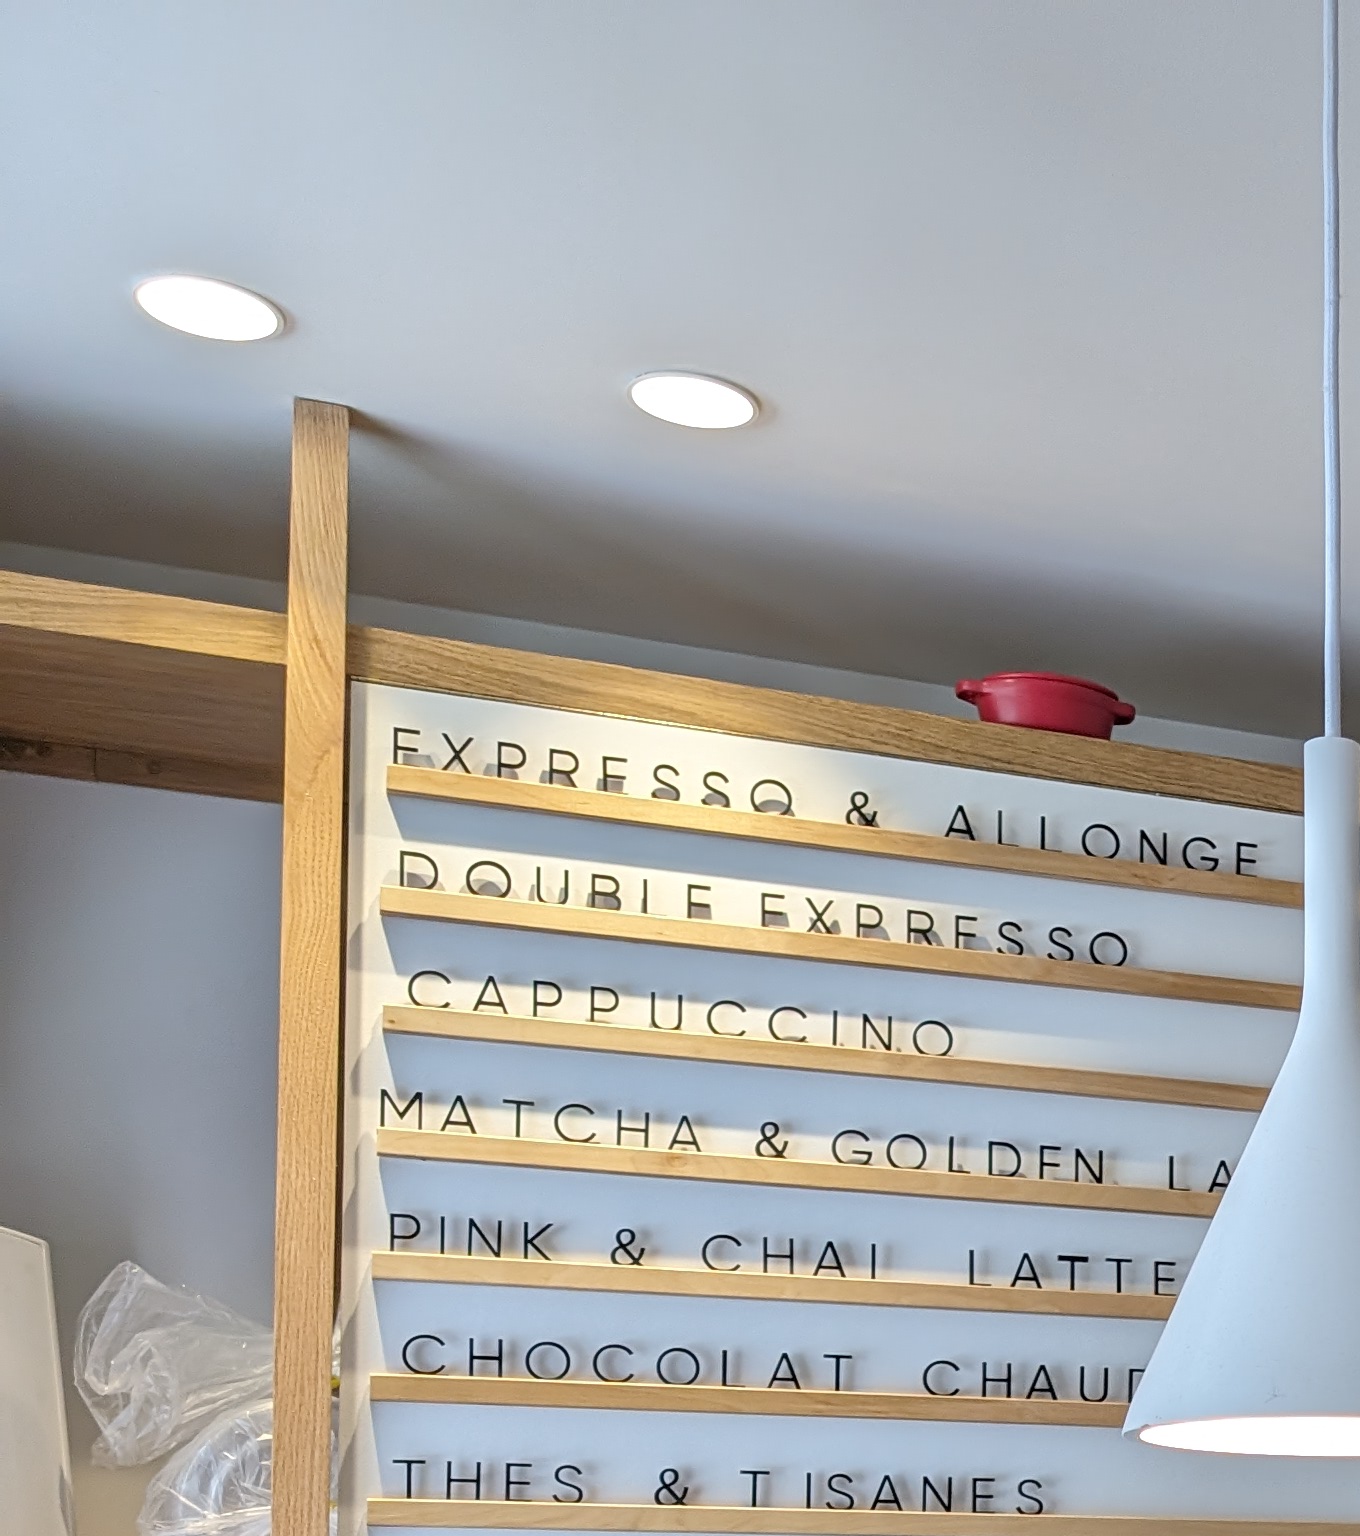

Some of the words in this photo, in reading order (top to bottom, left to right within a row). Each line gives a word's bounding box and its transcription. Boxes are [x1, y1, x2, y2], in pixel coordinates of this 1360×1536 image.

[392, 726, 795, 816] EXPRESSO
[845, 791, 879, 827] &
[943, 803, 1259, 877] ALLONGE
[399, 850, 712, 919] DOUBLE
[760, 892, 1128, 967] EXPRESSO
[408, 970, 954, 1057] CAPPUCCINO
[380, 1088, 702, 1152] MATCHA
[754, 1121, 790, 1158] &
[831, 1129, 1104, 1186] GOLDEN
[389, 1213, 555, 1261] PINK
[610, 1227, 646, 1267] &
[701, 1234, 878, 1280] CHAI
[968, 1249, 1177, 1297] LATTE
[401, 1333, 853, 1393] CHOCOLAT
[393, 1459, 584, 1504] THES
[653, 1468, 690, 1506] &
[740, 1469, 1046, 1516] TISANES
